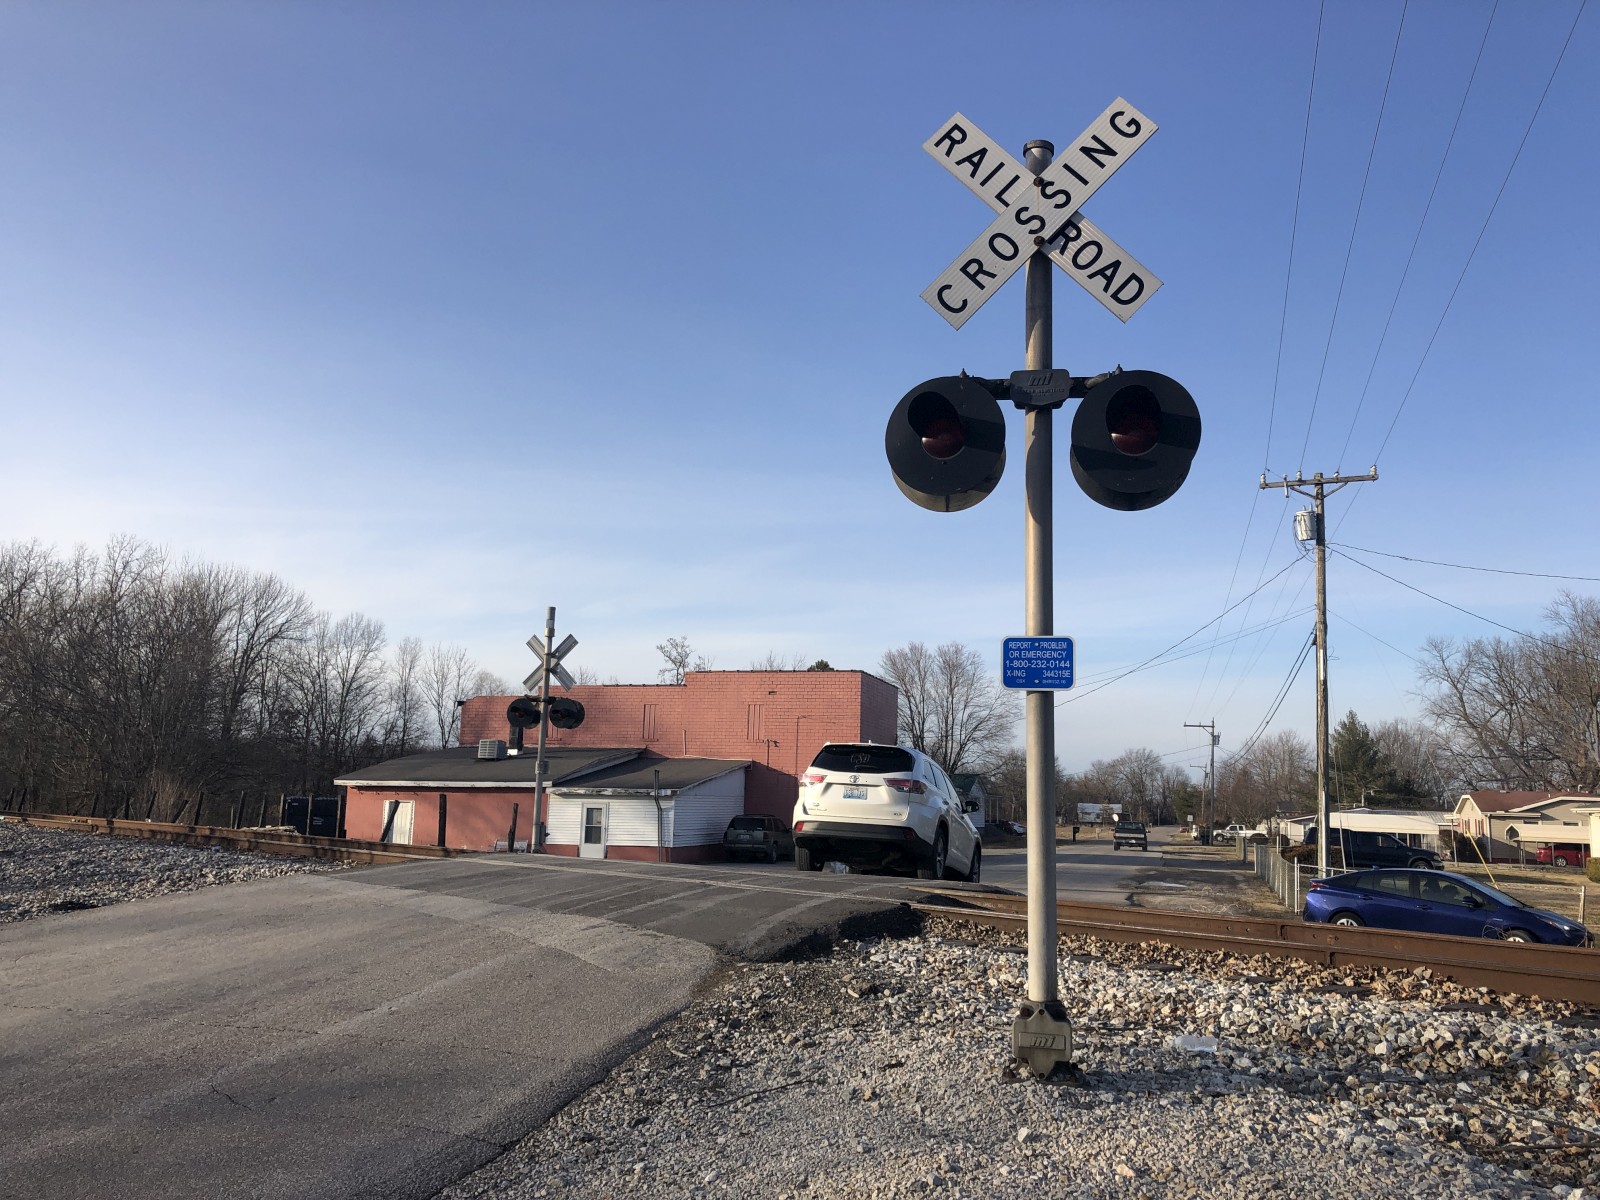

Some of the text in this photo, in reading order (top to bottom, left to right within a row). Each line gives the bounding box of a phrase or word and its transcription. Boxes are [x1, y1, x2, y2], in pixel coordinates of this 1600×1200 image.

[933, 123, 1145, 305] RAIL ROAD
[936, 110, 1142, 314] CROSSING
[1022, 650, 1066, 658] EMERGENCY
[1005, 660, 1070, 668] 1-800-232-0144
[1042, 670, 1071, 678] 344315E
